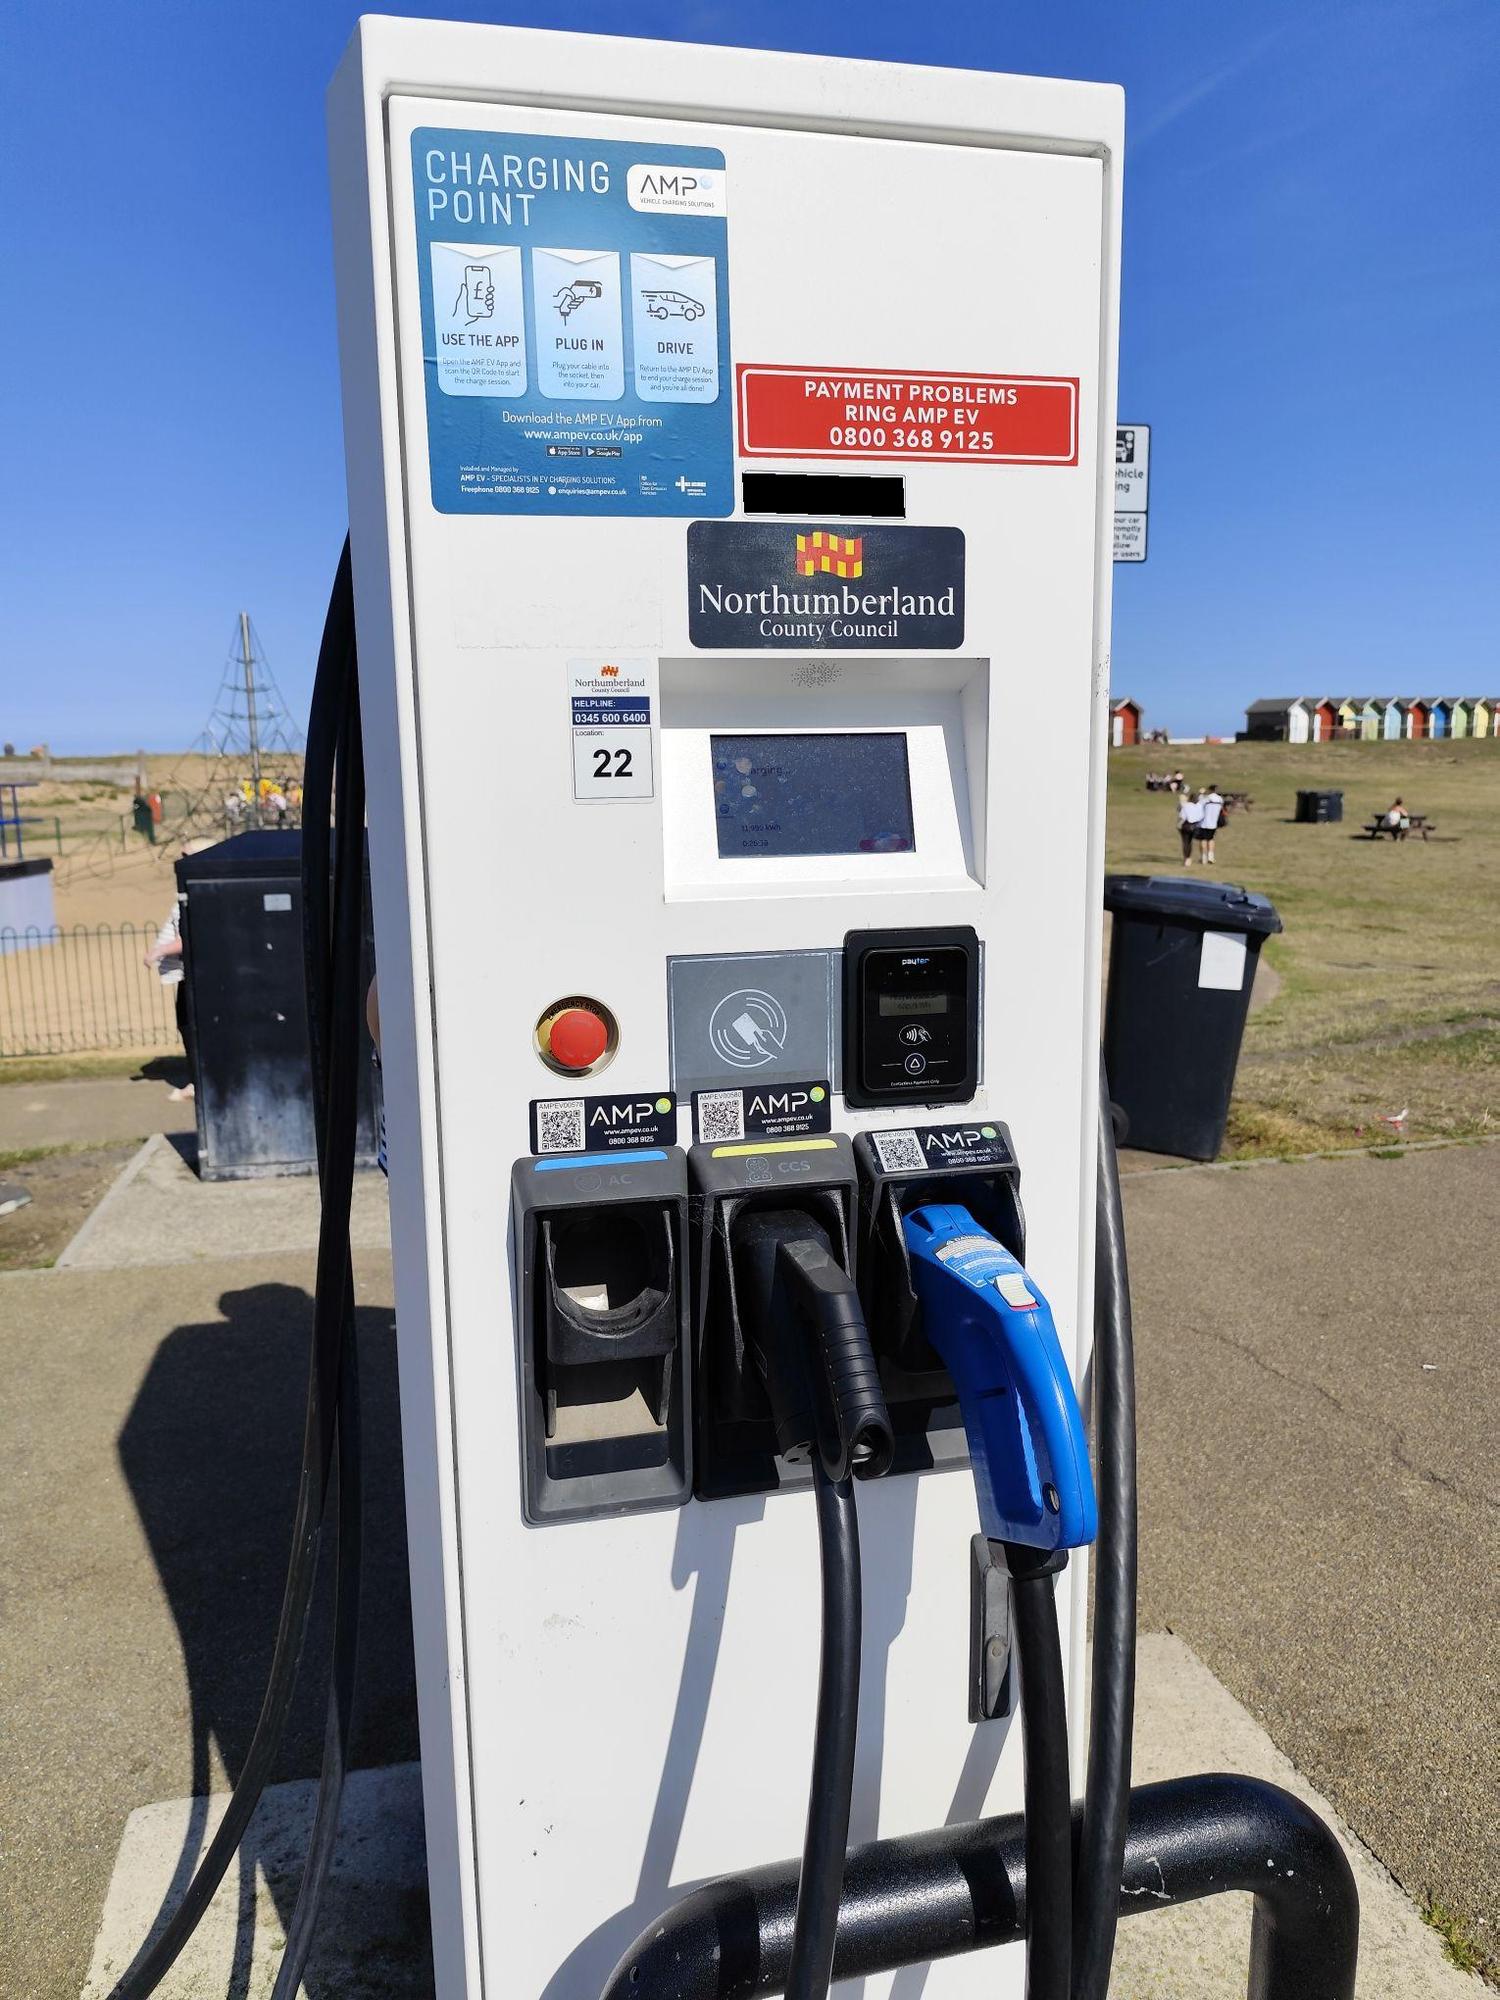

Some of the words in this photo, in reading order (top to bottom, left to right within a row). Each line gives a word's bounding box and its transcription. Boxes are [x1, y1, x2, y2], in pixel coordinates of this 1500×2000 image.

[426, 150, 610, 194] CHARGING
[640, 174, 697, 195] AMP
[428, 188, 536, 226] POINT
[442, 333, 465, 345] USE
[469, 334, 492, 346] THE
[496, 336, 519, 347] APP
[556, 338, 587, 350] PLUG
[592, 339, 604, 351] IN
[658, 342, 693, 354] DRIVE
[552, 362, 567, 371] Plug
[640, 364, 659, 372] Return
[702, 367, 713, 375] App
[466, 378, 486, 386] charge
[805, 380, 903, 401] PAYMENT
[909, 385, 1017, 405] PROBLEMS
[503, 411, 553, 424] Download
[556, 413, 572, 424] the
[575, 414, 597, 425] AMP
[601, 414, 613, 425] EV
[616, 415, 636, 428] App
[639, 415, 662, 427] from
[845, 405, 897, 423] RING
[902, 407, 948, 424] AMP
[954, 409, 979, 425] EV
[524, 429, 642, 444] www.ampev.co.uk/app
[829, 427, 886, 447] 0800
[893, 429, 933, 449] 368
[942, 430, 994, 450] 9125
[462, 485, 493, 493] Freephone
[558, 488, 626, 496] enquiries@ampev.co.uk
[700, 584, 955, 616] Northumberland
[760, 619, 825, 642] County
[831, 620, 898, 637] Council
[575, 678, 645, 687] Northumberland
[575, 714, 599, 723] 0345
[602, 713, 620, 722] 600
[623, 713, 646, 722] 6400
[593, 749, 632, 777] 22
[749, 1092, 808, 1116] AMP
[590, 1103, 653, 1126] AMP
[762, 1114, 813, 1124] www.ampev.co.uk
[604, 1126, 658, 1135] www.ampev.co.uk
[926, 1131, 980, 1150] AMP
[778, 1160, 810, 1173] CCS
[608, 1174, 633, 1186] AC
